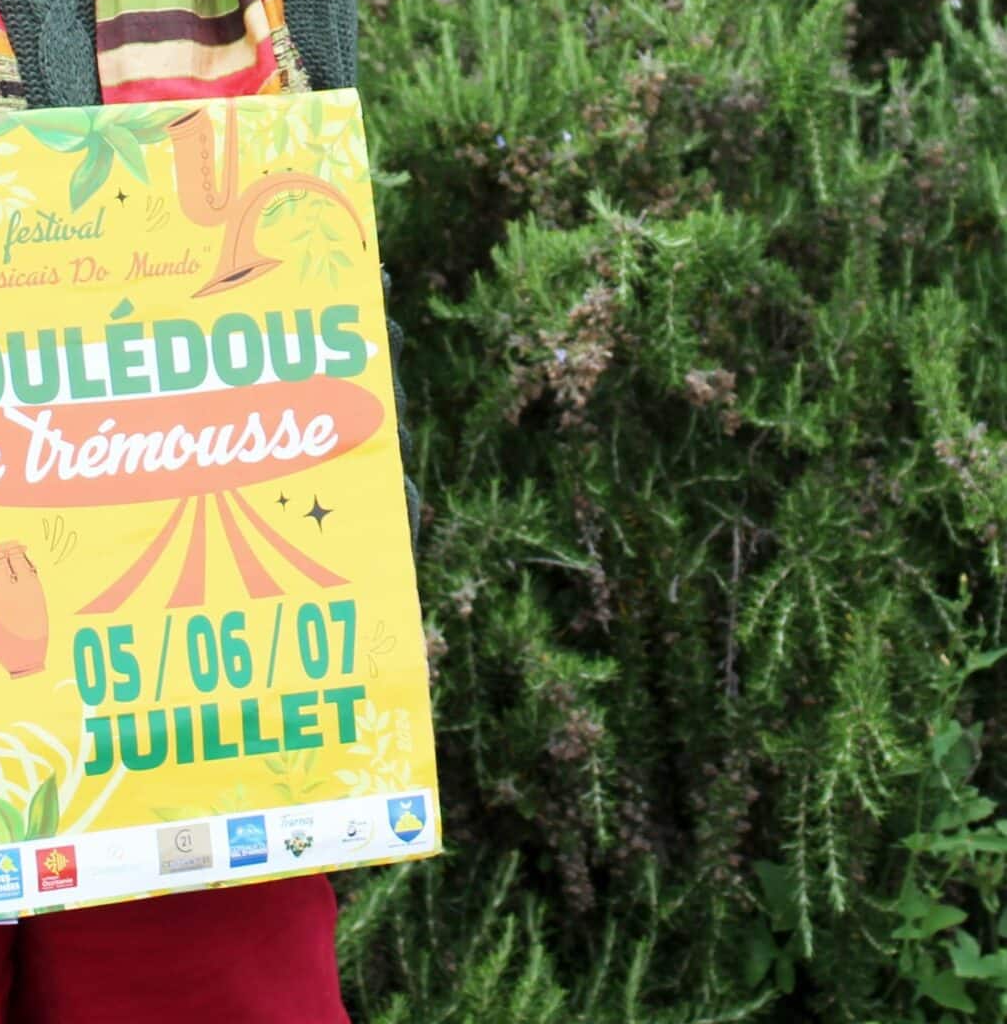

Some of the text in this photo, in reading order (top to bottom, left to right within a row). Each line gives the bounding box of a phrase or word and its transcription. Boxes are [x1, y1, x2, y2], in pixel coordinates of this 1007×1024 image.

[3, 206, 105, 264] festival
[69, 256, 110, 284] Do
[4, 407, 339, 484] trémousse
[84, 685, 366, 776] JUILLET
